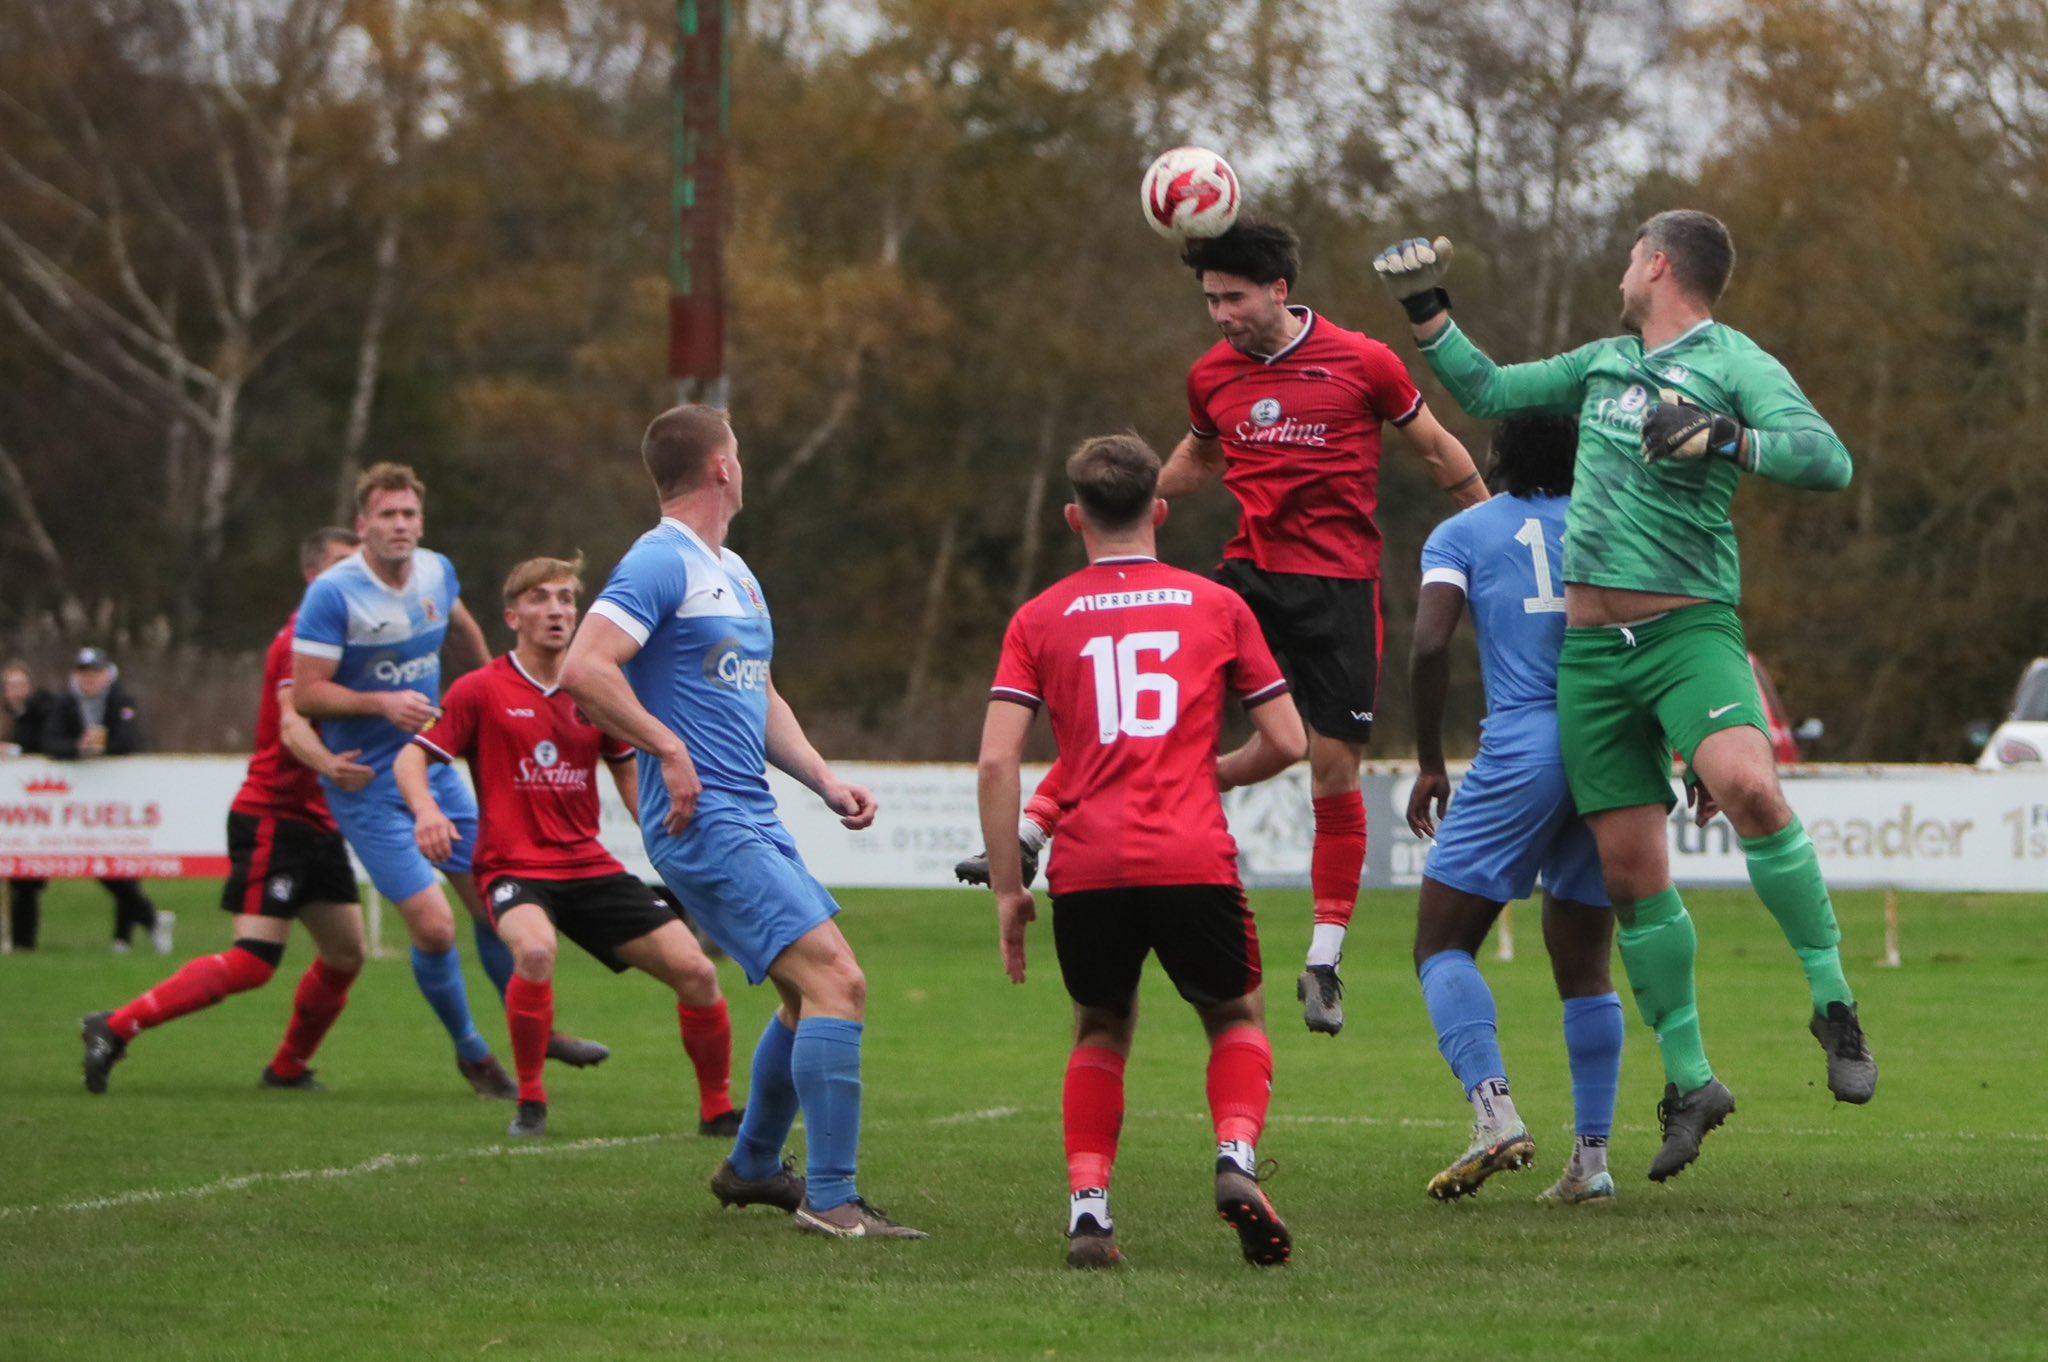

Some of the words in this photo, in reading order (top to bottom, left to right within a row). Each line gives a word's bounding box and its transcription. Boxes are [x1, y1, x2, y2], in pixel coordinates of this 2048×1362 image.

[1233, 417, 1328, 447] Sterling
[1514, 518, 1567, 613] 1
[1098, 589, 1190, 608] PROPERTY
[718, 651, 769, 690] Cygne
[1080, 631, 1180, 744] 16
[514, 757, 590, 792] Sterling
[64, 802, 161, 828] FUELS
[1811, 804, 1973, 858] eader
